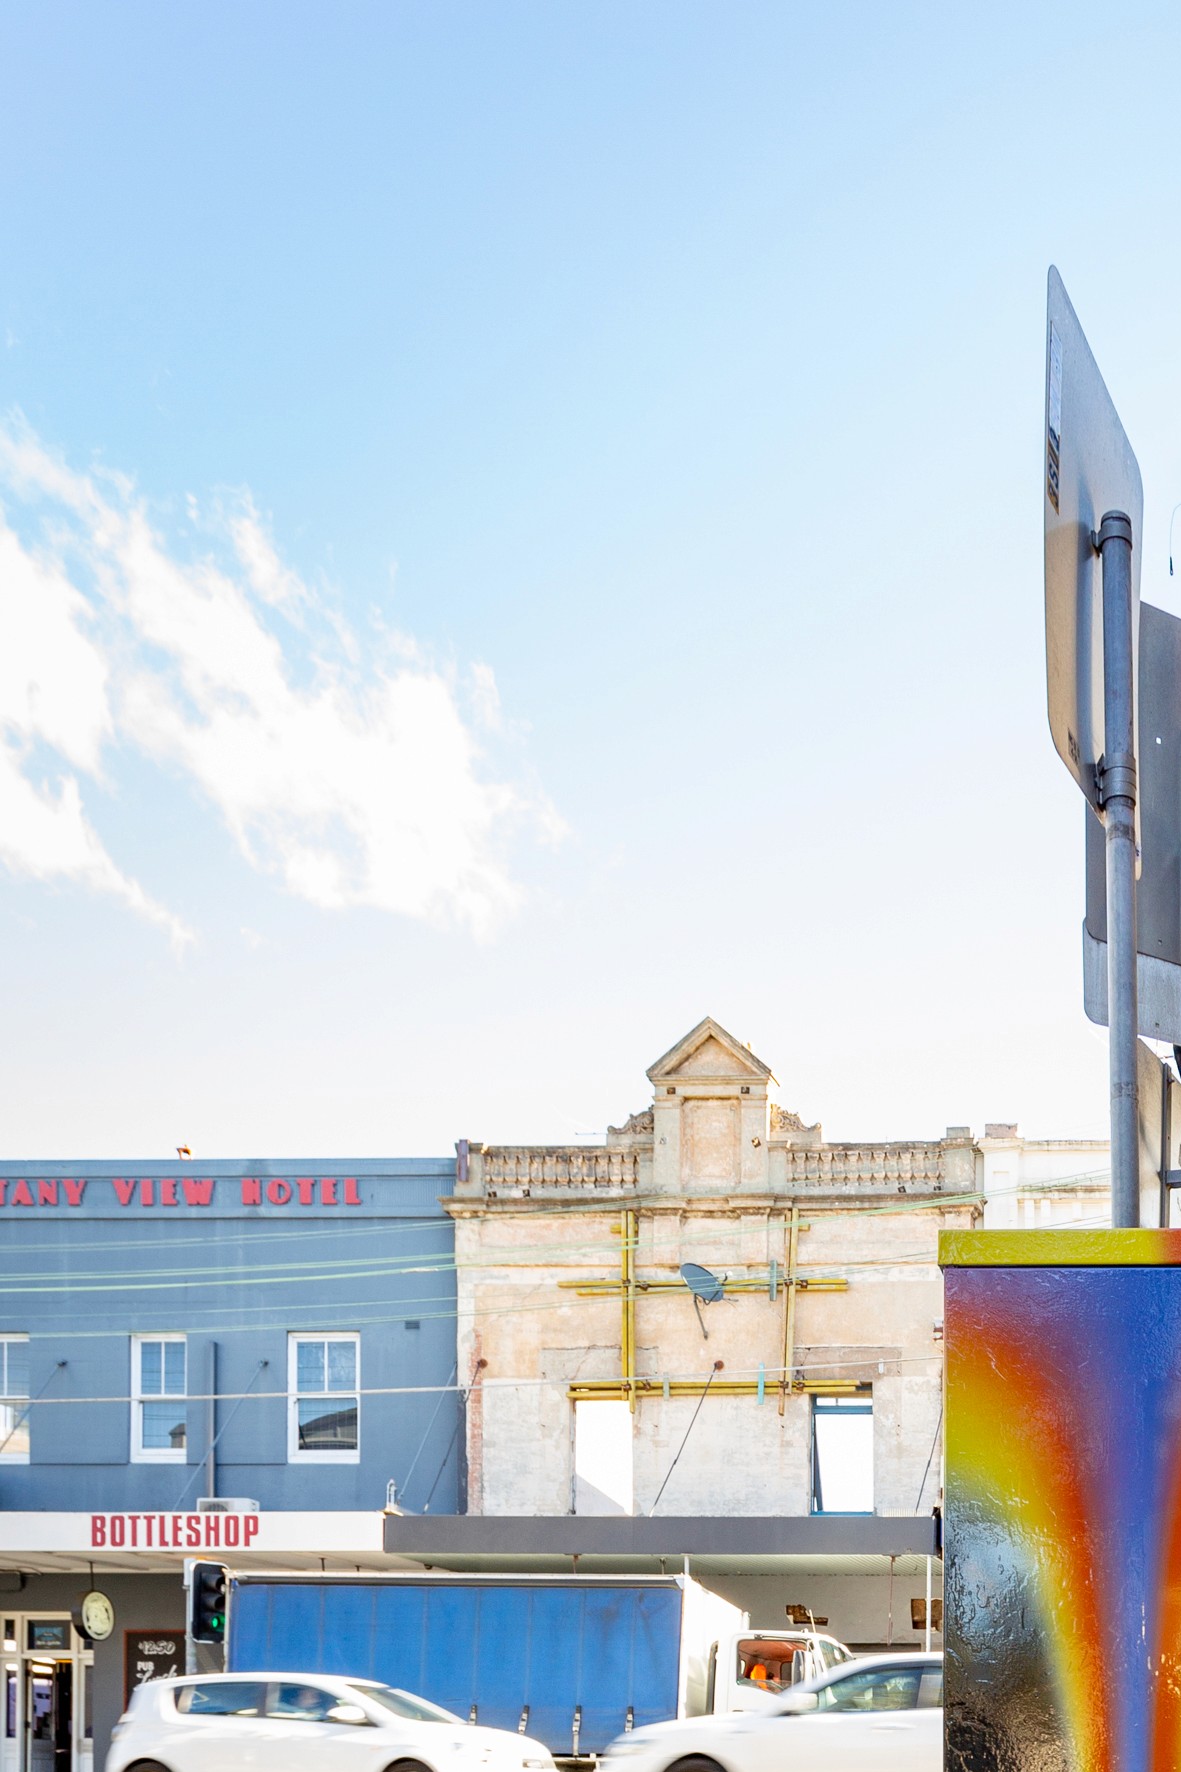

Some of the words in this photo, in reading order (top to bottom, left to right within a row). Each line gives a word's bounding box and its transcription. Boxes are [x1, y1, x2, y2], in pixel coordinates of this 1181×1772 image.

[113, 1178, 214, 1206] VIEW
[242, 1178, 362, 1205] HOTEL
[91, 1515, 259, 1547] BOTTLESHOP
[137, 1661, 155, 1672] PUB
